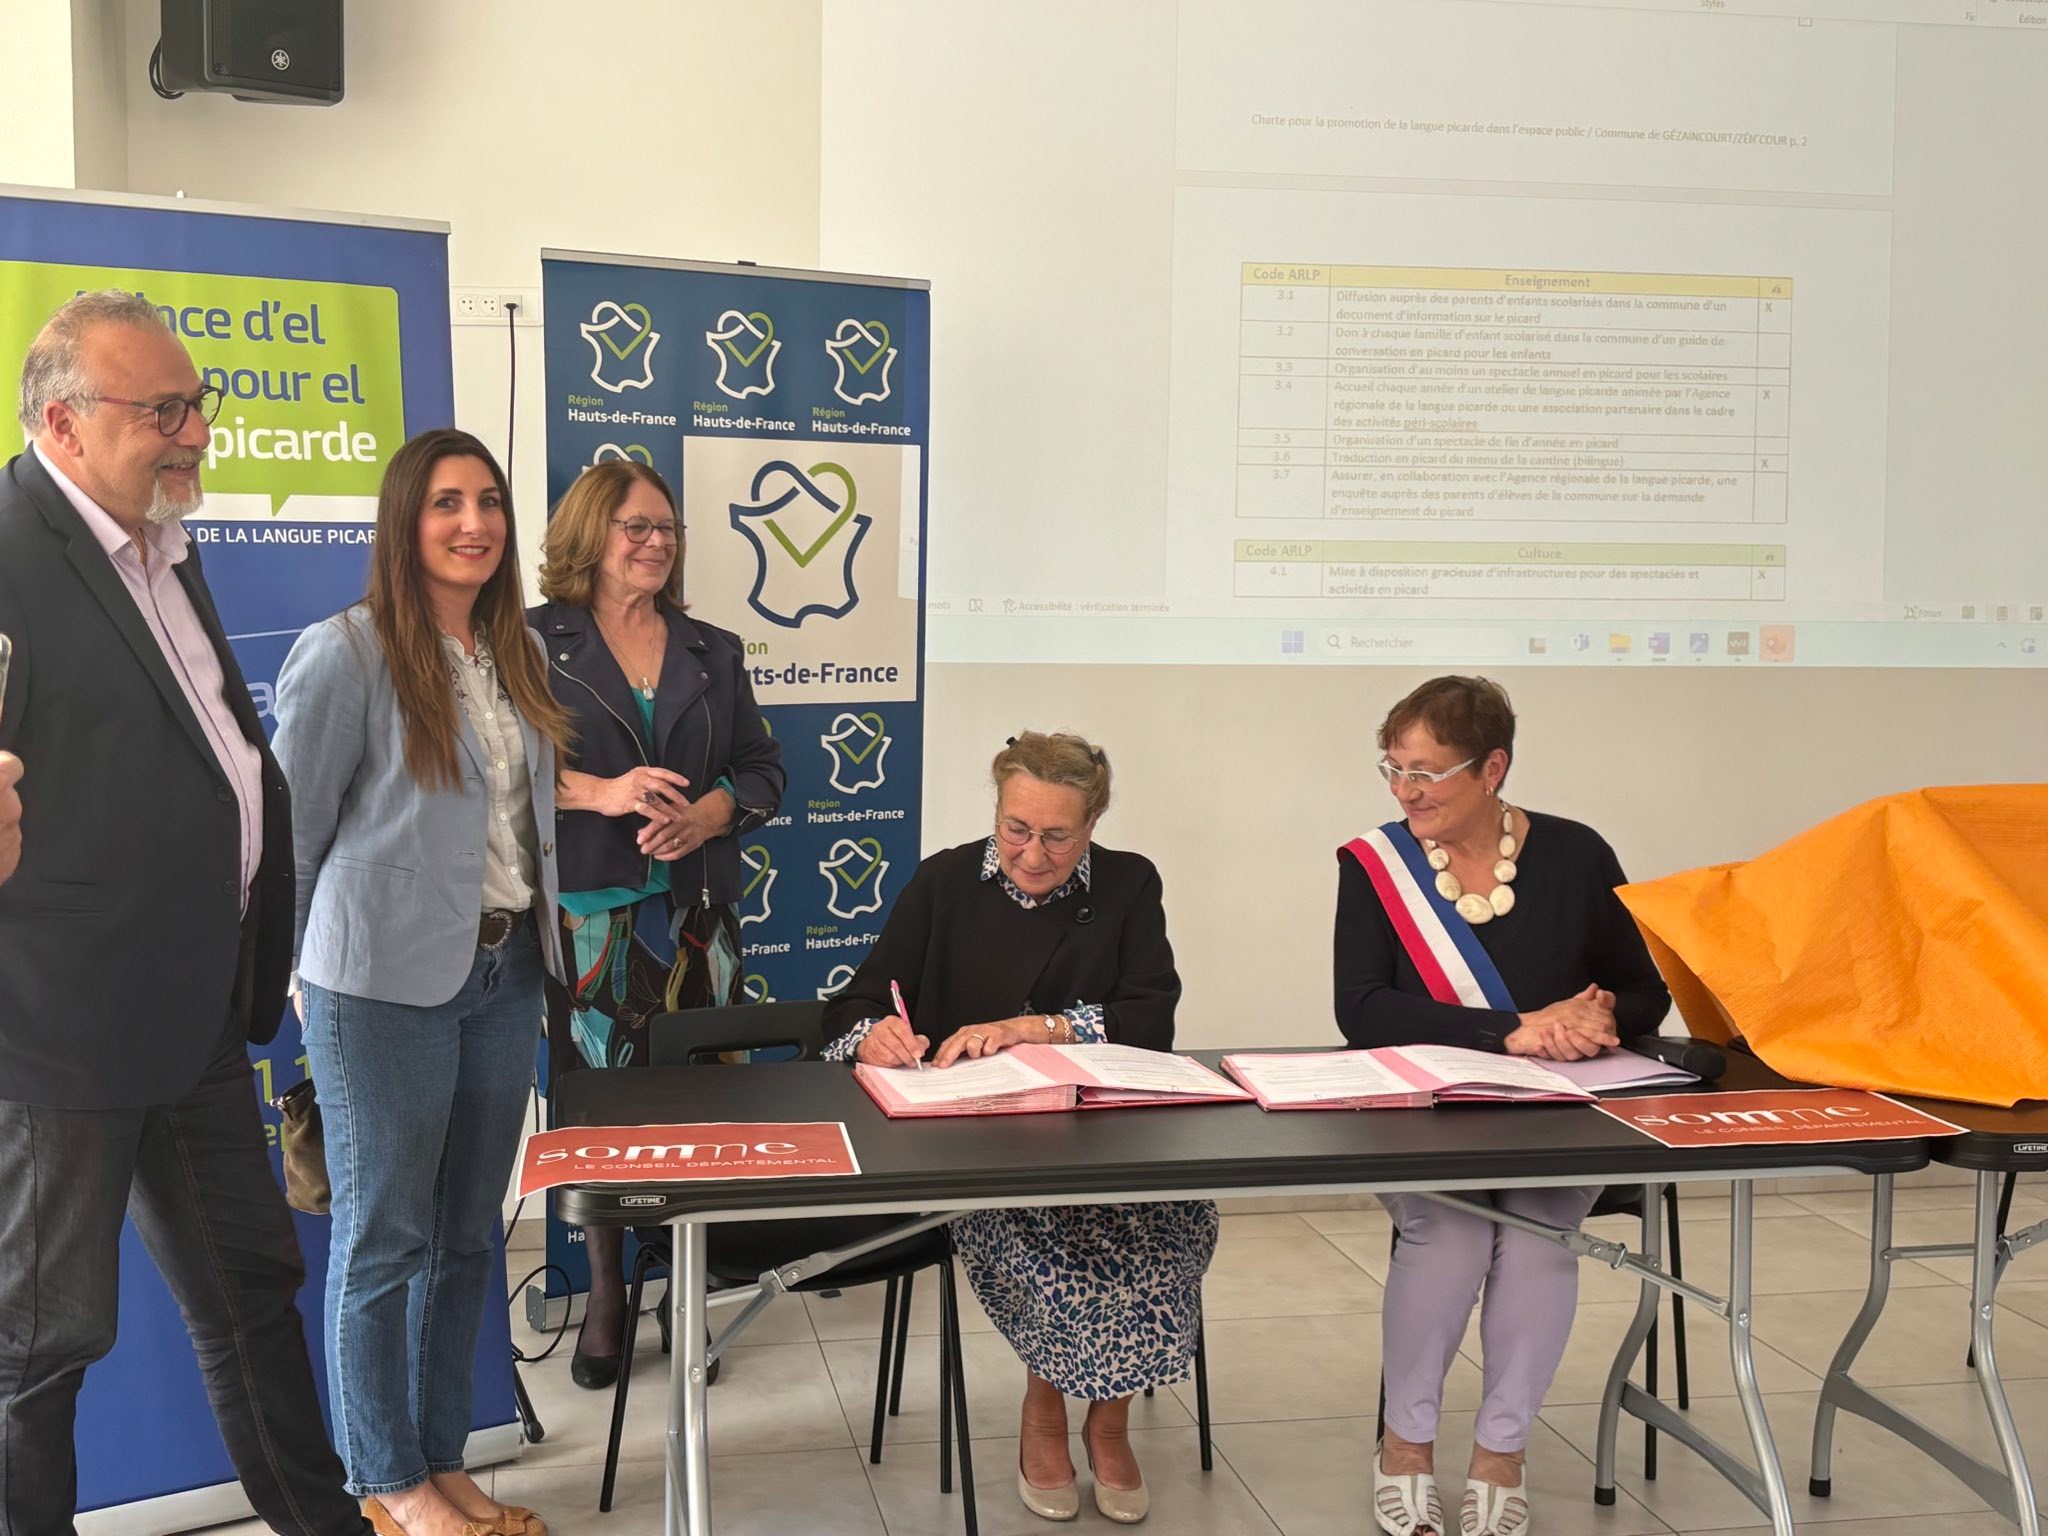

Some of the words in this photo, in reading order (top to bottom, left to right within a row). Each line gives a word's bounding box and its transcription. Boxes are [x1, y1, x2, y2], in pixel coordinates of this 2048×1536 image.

[1250, 113, 1286, 125] Charte
[1287, 117, 1312, 129] pour
[1314, 115, 1324, 127] la
[1326, 116, 1381, 131] promotion
[1383, 118, 1396, 129] de
[1398, 119, 1408, 130] la
[1410, 119, 1444, 134] langue
[1446, 120, 1484, 135] picarde
[1485, 122, 1510, 134] dans
[1554, 125, 1585, 139] public
[1594, 126, 1646, 139] Commune
[1647, 128, 1661, 140] de
[1788, 137, 1798, 147] p.
[1801, 134, 1808, 145] 2
[1254, 268, 1284, 280] Code
[1288, 268, 1320, 281] ARLP
[1504, 274, 1590, 289] Enseignement
[1276, 290, 1294, 300] 3.1
[1336, 291, 1386, 302] Diffusion
[1388, 292, 1426, 306] auprès
[1429, 293, 1449, 304] des
[1450, 293, 1494, 307] parents
[1549, 295, 1603, 307] scolarisés
[1604, 297, 1631, 308] dans
[1633, 297, 1643, 308] la
[1645, 300, 1700, 309] commune
[244, 300, 326, 345] d'el
[1336, 309, 1393, 320] document
[1494, 311, 1504, 322] le
[1506, 311, 1541, 325] picard
[1276, 326, 1293, 336] 3.2
[1334, 327, 1358, 338] Don
[1361, 327, 1368, 338] à
[1370, 327, 1411, 341] chaque
[1413, 328, 1452, 339] famille
[1502, 330, 1551, 341] scolarisé
[1553, 331, 1580, 342] dans
[1581, 332, 1592, 342] la
[1593, 335, 1649, 343] commune
[1678, 334, 1709, 347] guide
[1709, 334, 1725, 345] de
[1334, 345, 1406, 356] conversation
[1408, 349, 1423, 357] en
[1426, 346, 1461, 360] picard
[1463, 350, 1489, 360] pour
[1492, 347, 1508, 358] les
[1510, 348, 1551, 358] enfants
[1276, 362, 1292, 372] 3.3
[202, 366, 310, 402] pour
[322, 363, 365, 405] el
[1274, 380, 1292, 390] 3.4
[1333, 381, 1374, 392] Accueil
[1376, 381, 1417, 395] chaque
[1419, 382, 1454, 393] année
[1483, 383, 1519, 394] atelier
[1522, 384, 1536, 394] de
[1538, 384, 1576, 398] langue
[1578, 385, 1618, 398] picarde
[1620, 386, 1662, 397] animée
[1664, 389, 1682, 399] par
[568, 394, 604, 408] Région
[693, 401, 728, 414] Région
[1333, 399, 1385, 412] régionale
[1388, 400, 1402, 410] de
[1404, 400, 1415, 411] la
[1417, 400, 1455, 414] langue
[1457, 401, 1499, 414] picarde
[1500, 404, 1515, 412] ou
[1517, 404, 1539, 412] une
[1541, 402, 1602, 413] association
[1604, 403, 1662, 417] partenaire
[1664, 404, 1690, 415] dans
[1692, 404, 1702, 415] le
[1704, 404, 1735, 415] cadre
[568, 408, 677, 426] Hauts-de-France
[812, 406, 845, 419] Région
[693, 414, 796, 432] Hauts-de-France
[812, 420, 911, 436] Hauts-de-France
[207, 416, 377, 469] picarde
[1273, 434, 1291, 444] 3.5
[1273, 452, 1290, 462] 3.6
[1273, 470, 1290, 479] 3.7
[1330, 469, 1376, 483] Assurer,
[1396, 470, 1469, 481] collaboration
[1472, 474, 1497, 482] avec
[1549, 472, 1600, 485] régionale
[1602, 473, 1617, 483] de
[1618, 473, 1629, 483] la
[1631, 473, 1669, 486] langue
[1669, 474, 1714, 487] picarde,
[1716, 477, 1737, 485] une
[197, 528, 220, 542] DE
[226, 528, 248, 543] LA
[252, 528, 322, 544] LANGUE
[328, 529, 377, 544] PICAR
[1246, 545, 1277, 557] Code
[1281, 545, 1312, 557] ARLP
[1518, 548, 1562, 559] Culture
[1270, 567, 1286, 576] 4.1
[1328, 565, 1356, 576] Mise
[1358, 565, 1366, 576] à
[1367, 565, 1428, 579] disposition
[1430, 566, 1483, 579] gracieuse
[1578, 570, 1606, 581] pour
[1608, 568, 1628, 578] des
[1629, 568, 1686, 581] spectacles
[1687, 568, 1700, 579] et
[1328, 583, 1375, 594] activités
[1377, 586, 1391, 594] en
[1393, 583, 1429, 597] picard
[1350, 636, 1414, 648] Rechercher
[752, 662, 898, 685] ts-de-France
[808, 800, 840, 810] Région
[808, 810, 904, 823] Hauts-de-France
[806, 925, 838, 935] Région
[806, 934, 880, 949] Hauts-de-Fr
[1633, 1105, 1870, 1128] somme
[536, 1142, 799, 1166] somme
